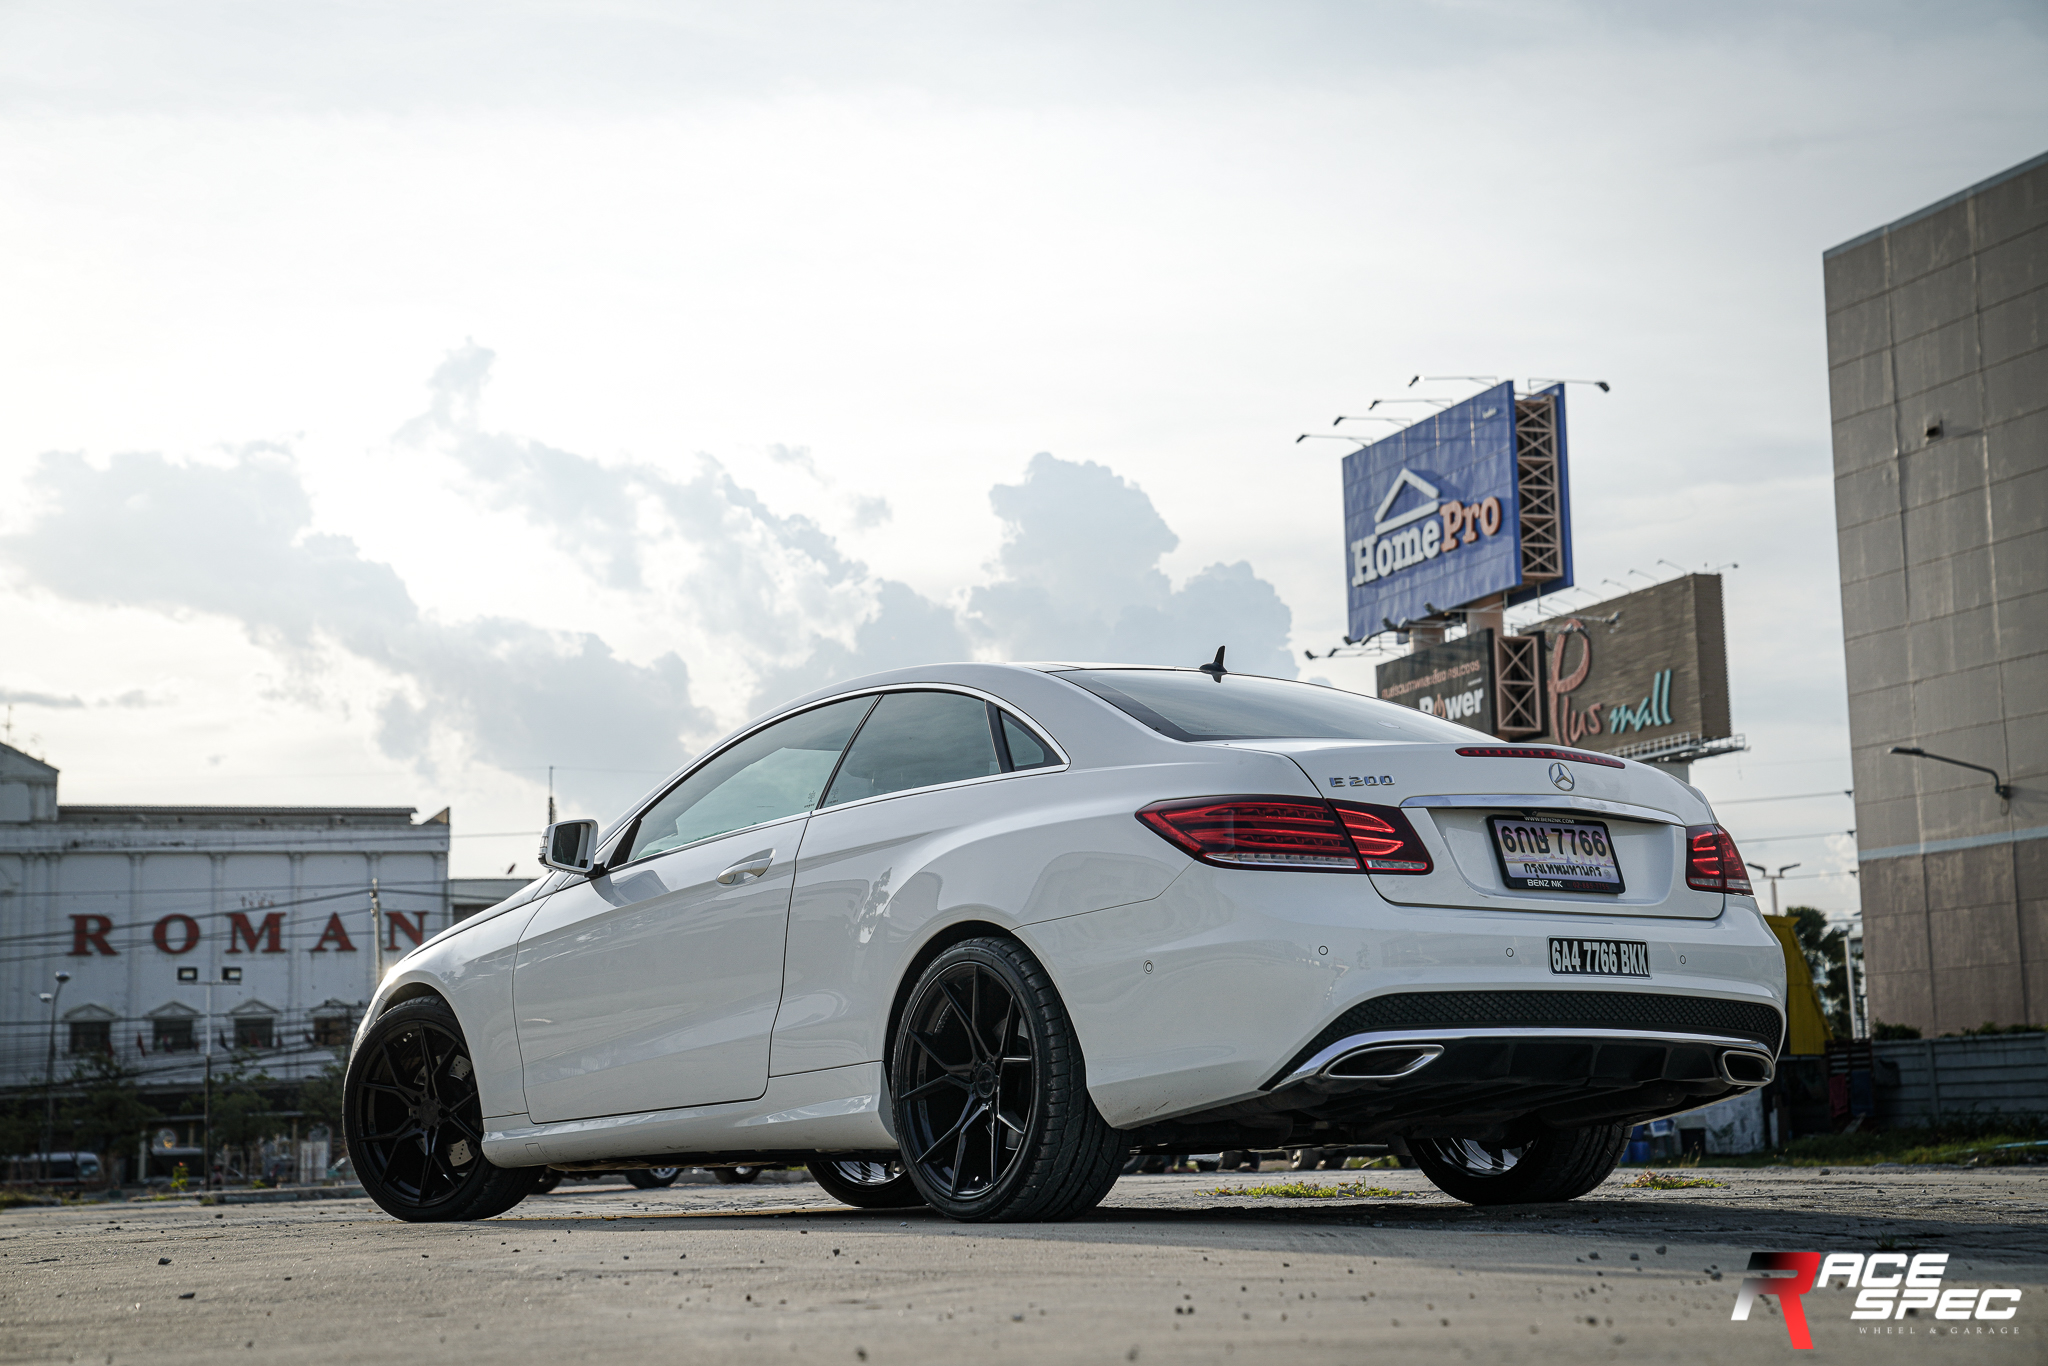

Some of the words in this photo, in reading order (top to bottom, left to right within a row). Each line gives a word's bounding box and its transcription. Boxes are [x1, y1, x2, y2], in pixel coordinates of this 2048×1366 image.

[1351, 496, 1501, 587] HomePro
[1547, 618, 1602, 746] Plus
[1609, 668, 1673, 734] mall
[1329, 777, 1346, 788] E
[1349, 775, 1396, 787] 200
[1524, 816, 1575, 824] WWW.BENZNK.COM
[1551, 828, 1607, 857] 7766
[1523, 863, 1602, 878] กรุงเทพมหานคร
[1527, 879, 1549, 888] BENZ
[1551, 880, 1563, 888] NK
[68, 912, 429, 956] ROMAN
[1551, 940, 1581, 972] 6A4
[1583, 941, 1618, 974] 7766
[1620, 943, 1649, 975] BKK
